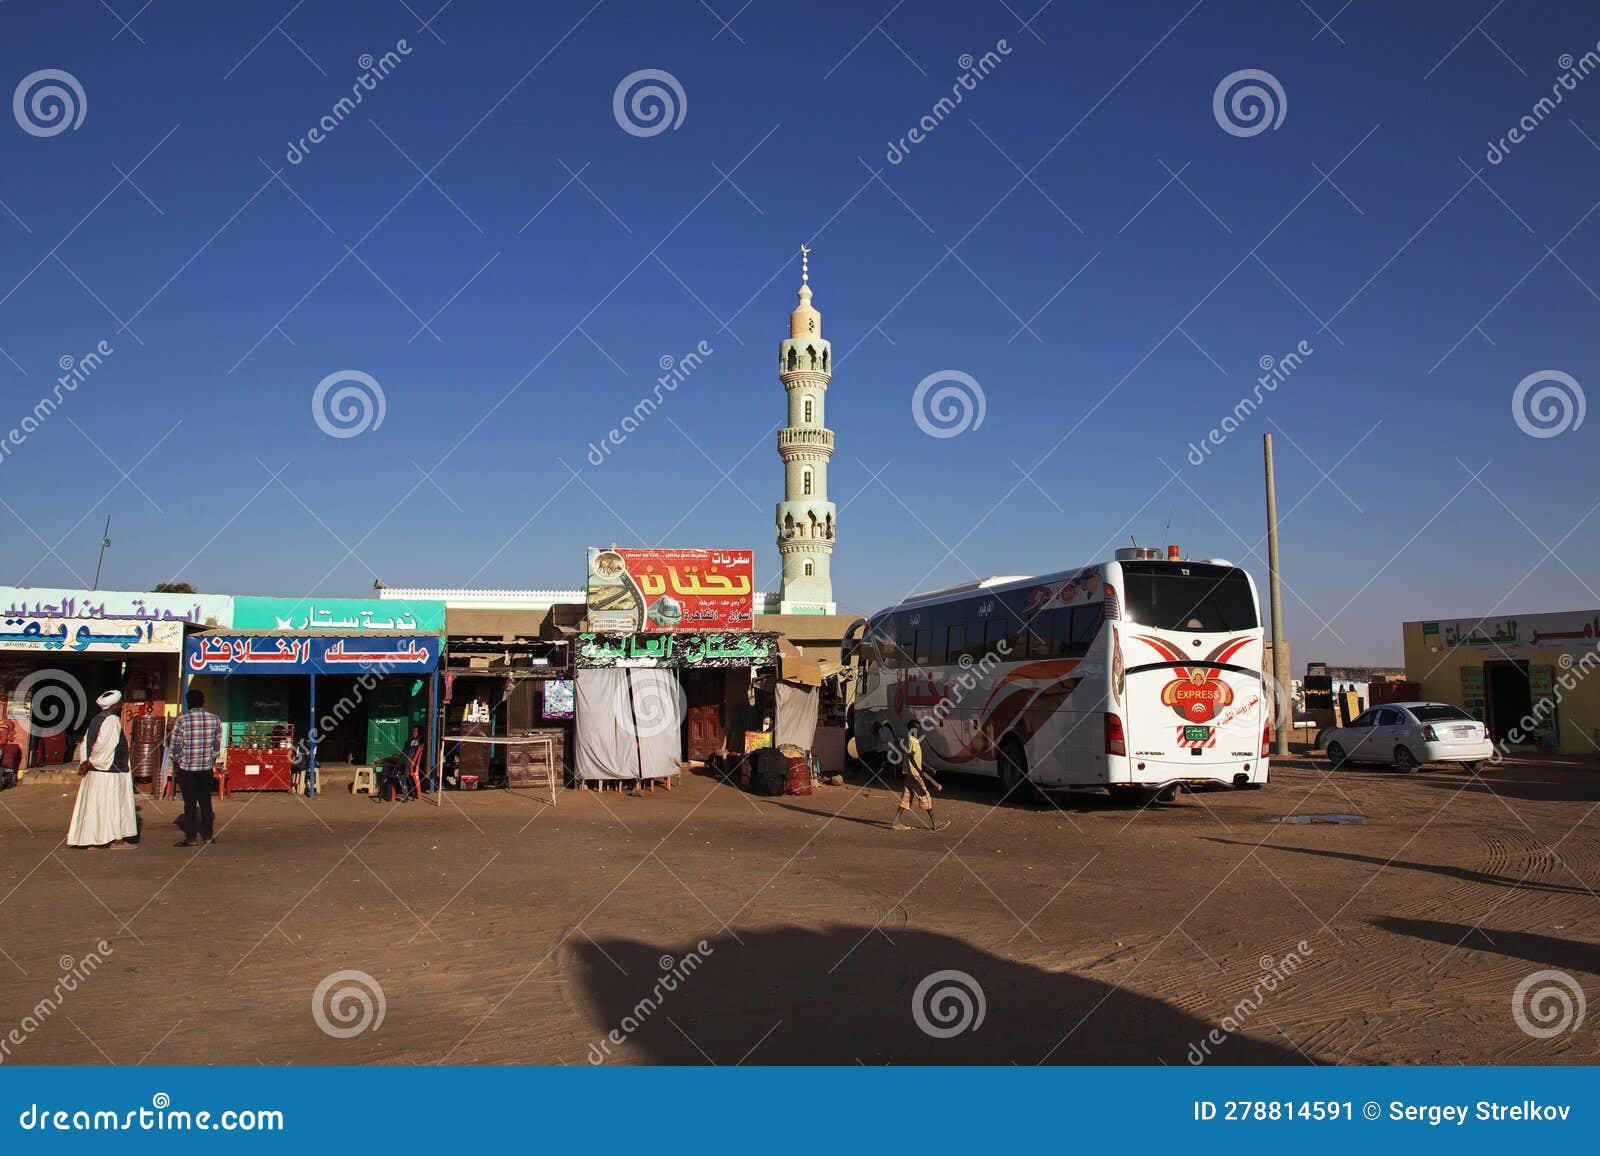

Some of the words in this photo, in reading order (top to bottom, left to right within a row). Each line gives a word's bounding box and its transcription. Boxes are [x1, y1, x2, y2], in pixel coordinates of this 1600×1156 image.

[635, 565, 752, 604] بختان
[189, 637, 311, 670] الفلافل
[324, 638, 430, 665] ملك
[1177, 690, 1220, 699] EXPRESS
